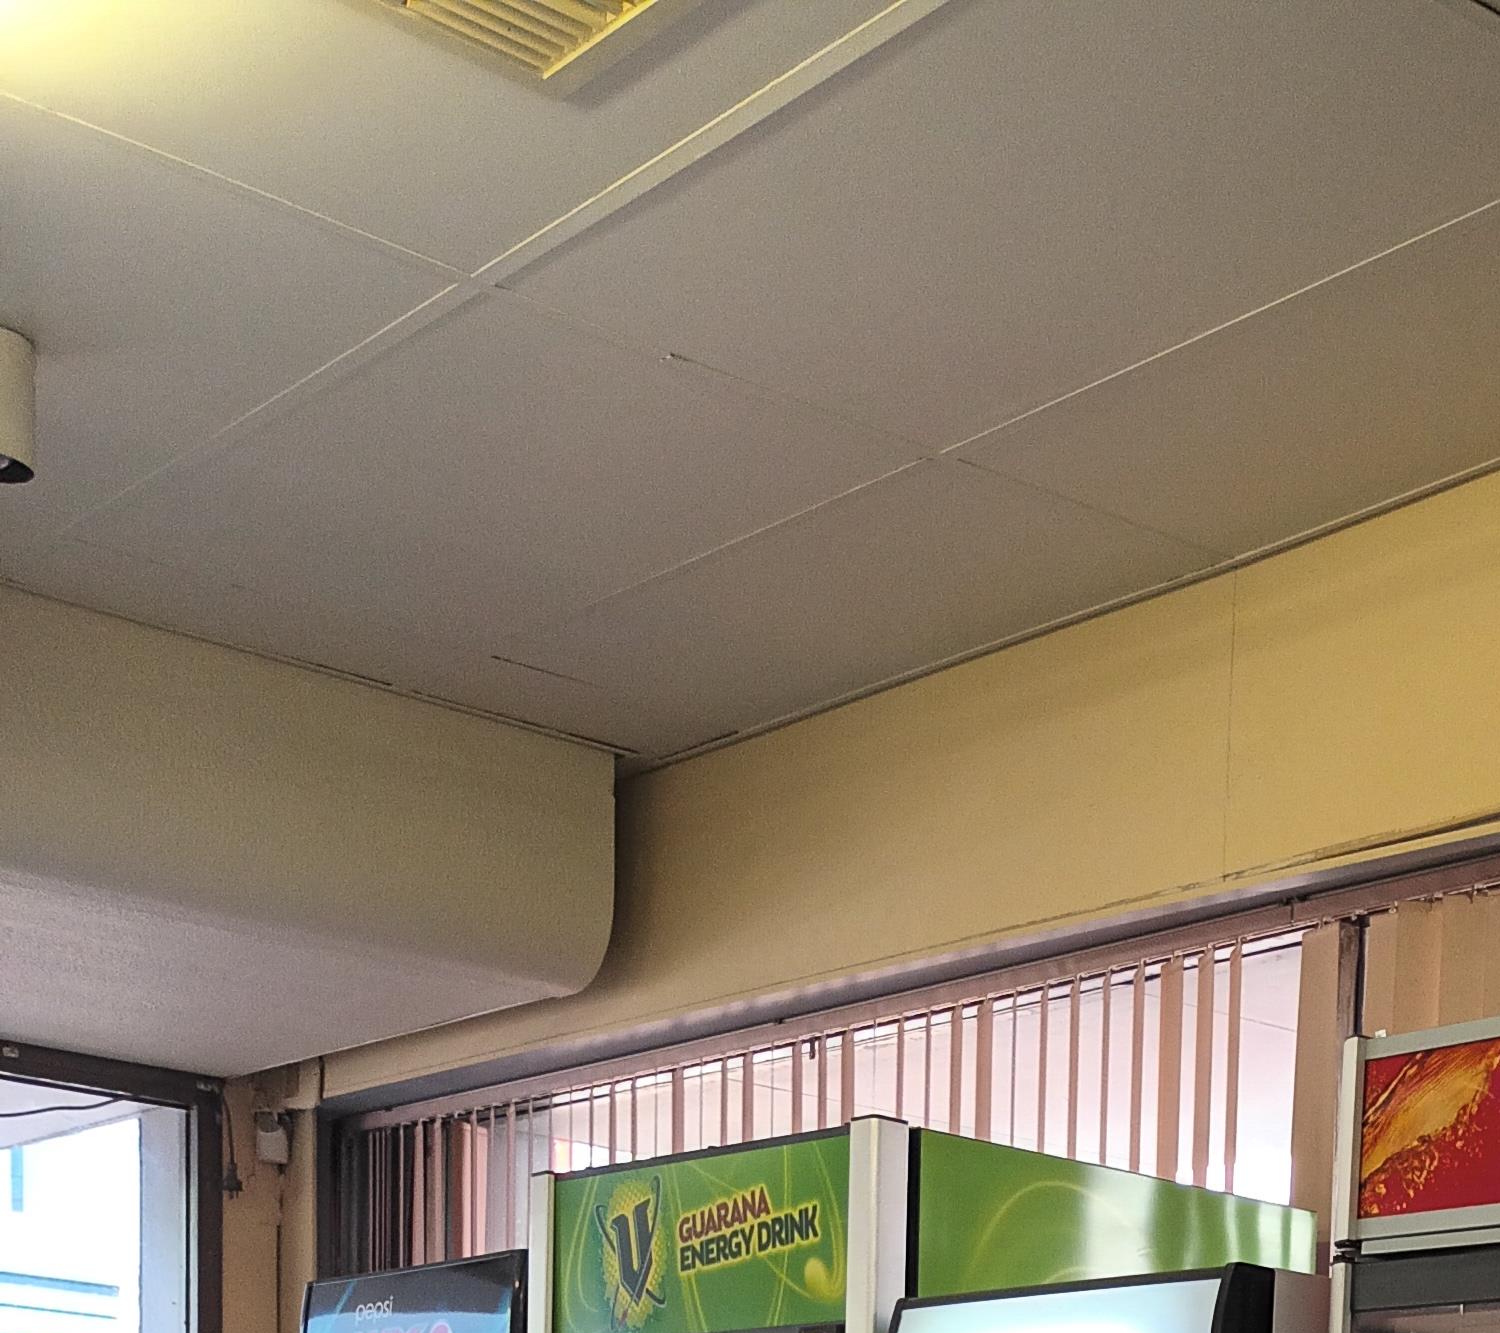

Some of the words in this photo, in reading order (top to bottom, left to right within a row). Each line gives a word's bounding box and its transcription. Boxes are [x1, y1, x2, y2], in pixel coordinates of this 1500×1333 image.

[678, 1186, 771, 1244] GUARANA
[679, 1226, 755, 1273] ENERGY
[757, 1204, 820, 1254] DRINK
[354, 1296, 394, 1326] pepsi
